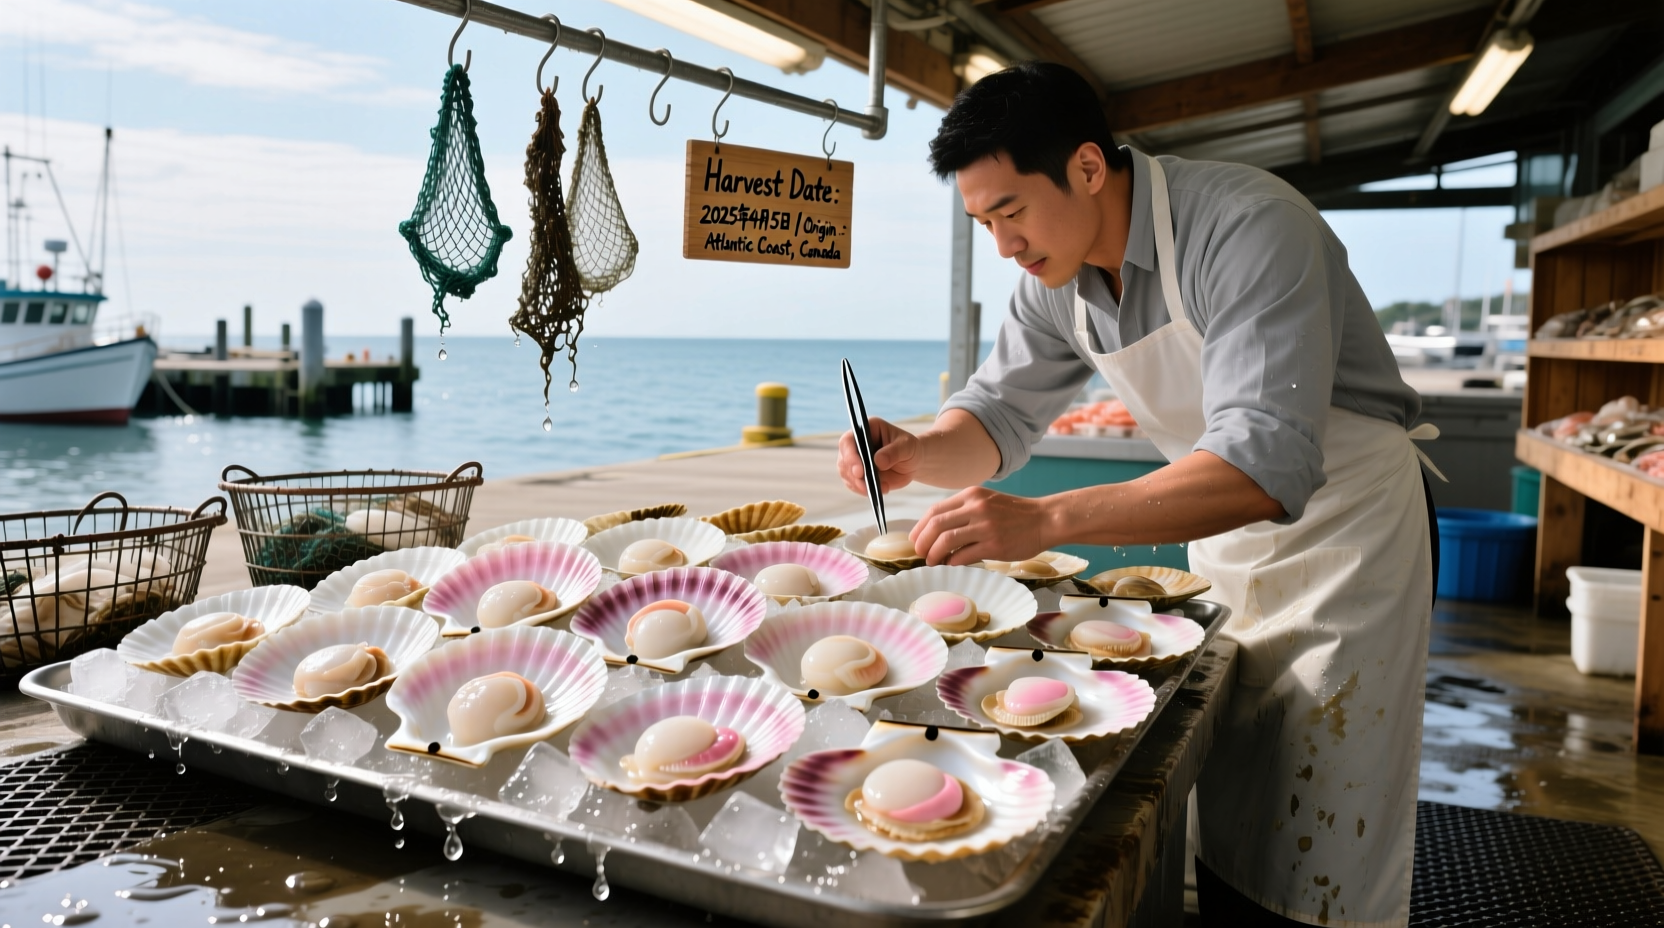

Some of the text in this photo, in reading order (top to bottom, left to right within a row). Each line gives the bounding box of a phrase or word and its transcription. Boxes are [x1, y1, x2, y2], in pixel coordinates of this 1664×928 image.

[704, 157, 840, 204] Harvest Date:
[699, 203, 791, 231] 2025年4月5日
[704, 232, 754, 252] Atlantic
[757, 236, 795, 260] Coast,
